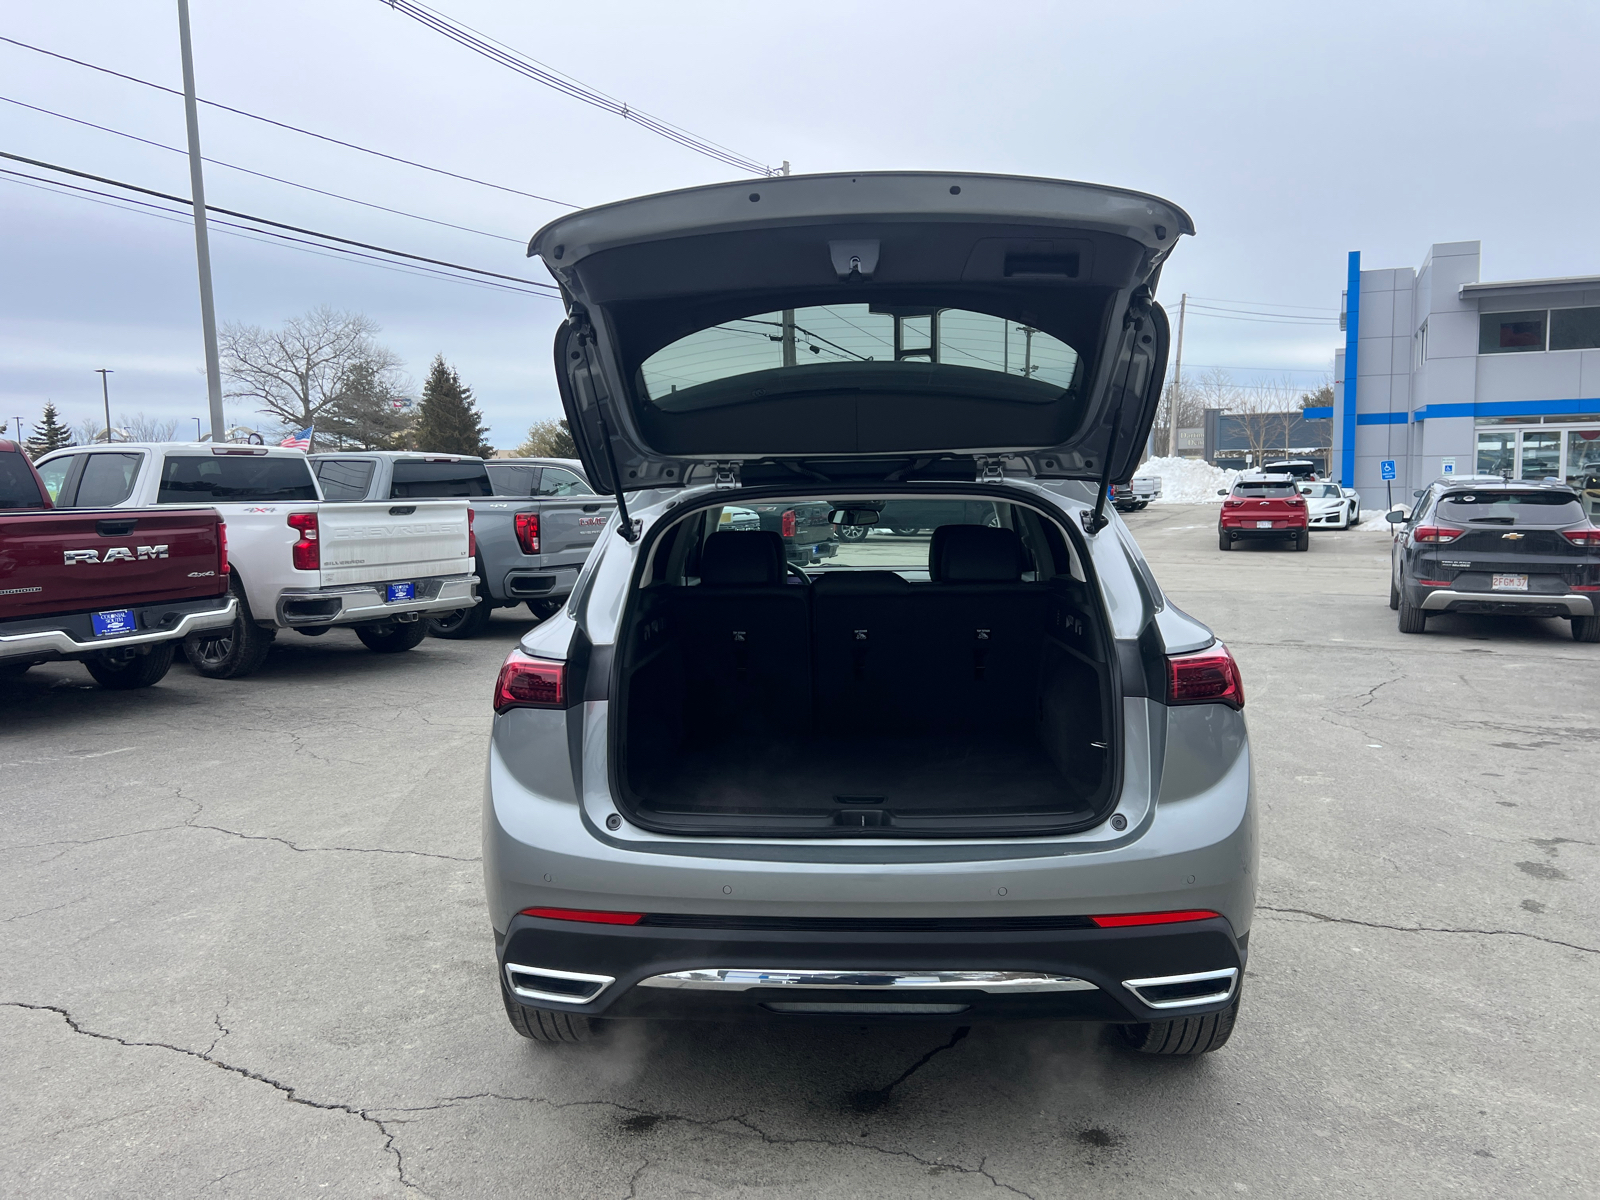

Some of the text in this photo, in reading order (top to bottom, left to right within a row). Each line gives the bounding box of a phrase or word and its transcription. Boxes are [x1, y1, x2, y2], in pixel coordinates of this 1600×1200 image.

[579, 516, 607, 526] GMC
[334, 523, 462, 539] CHEVROLET
[63, 544, 169, 566] RAM
[1516, 578, 1527, 587] 37
